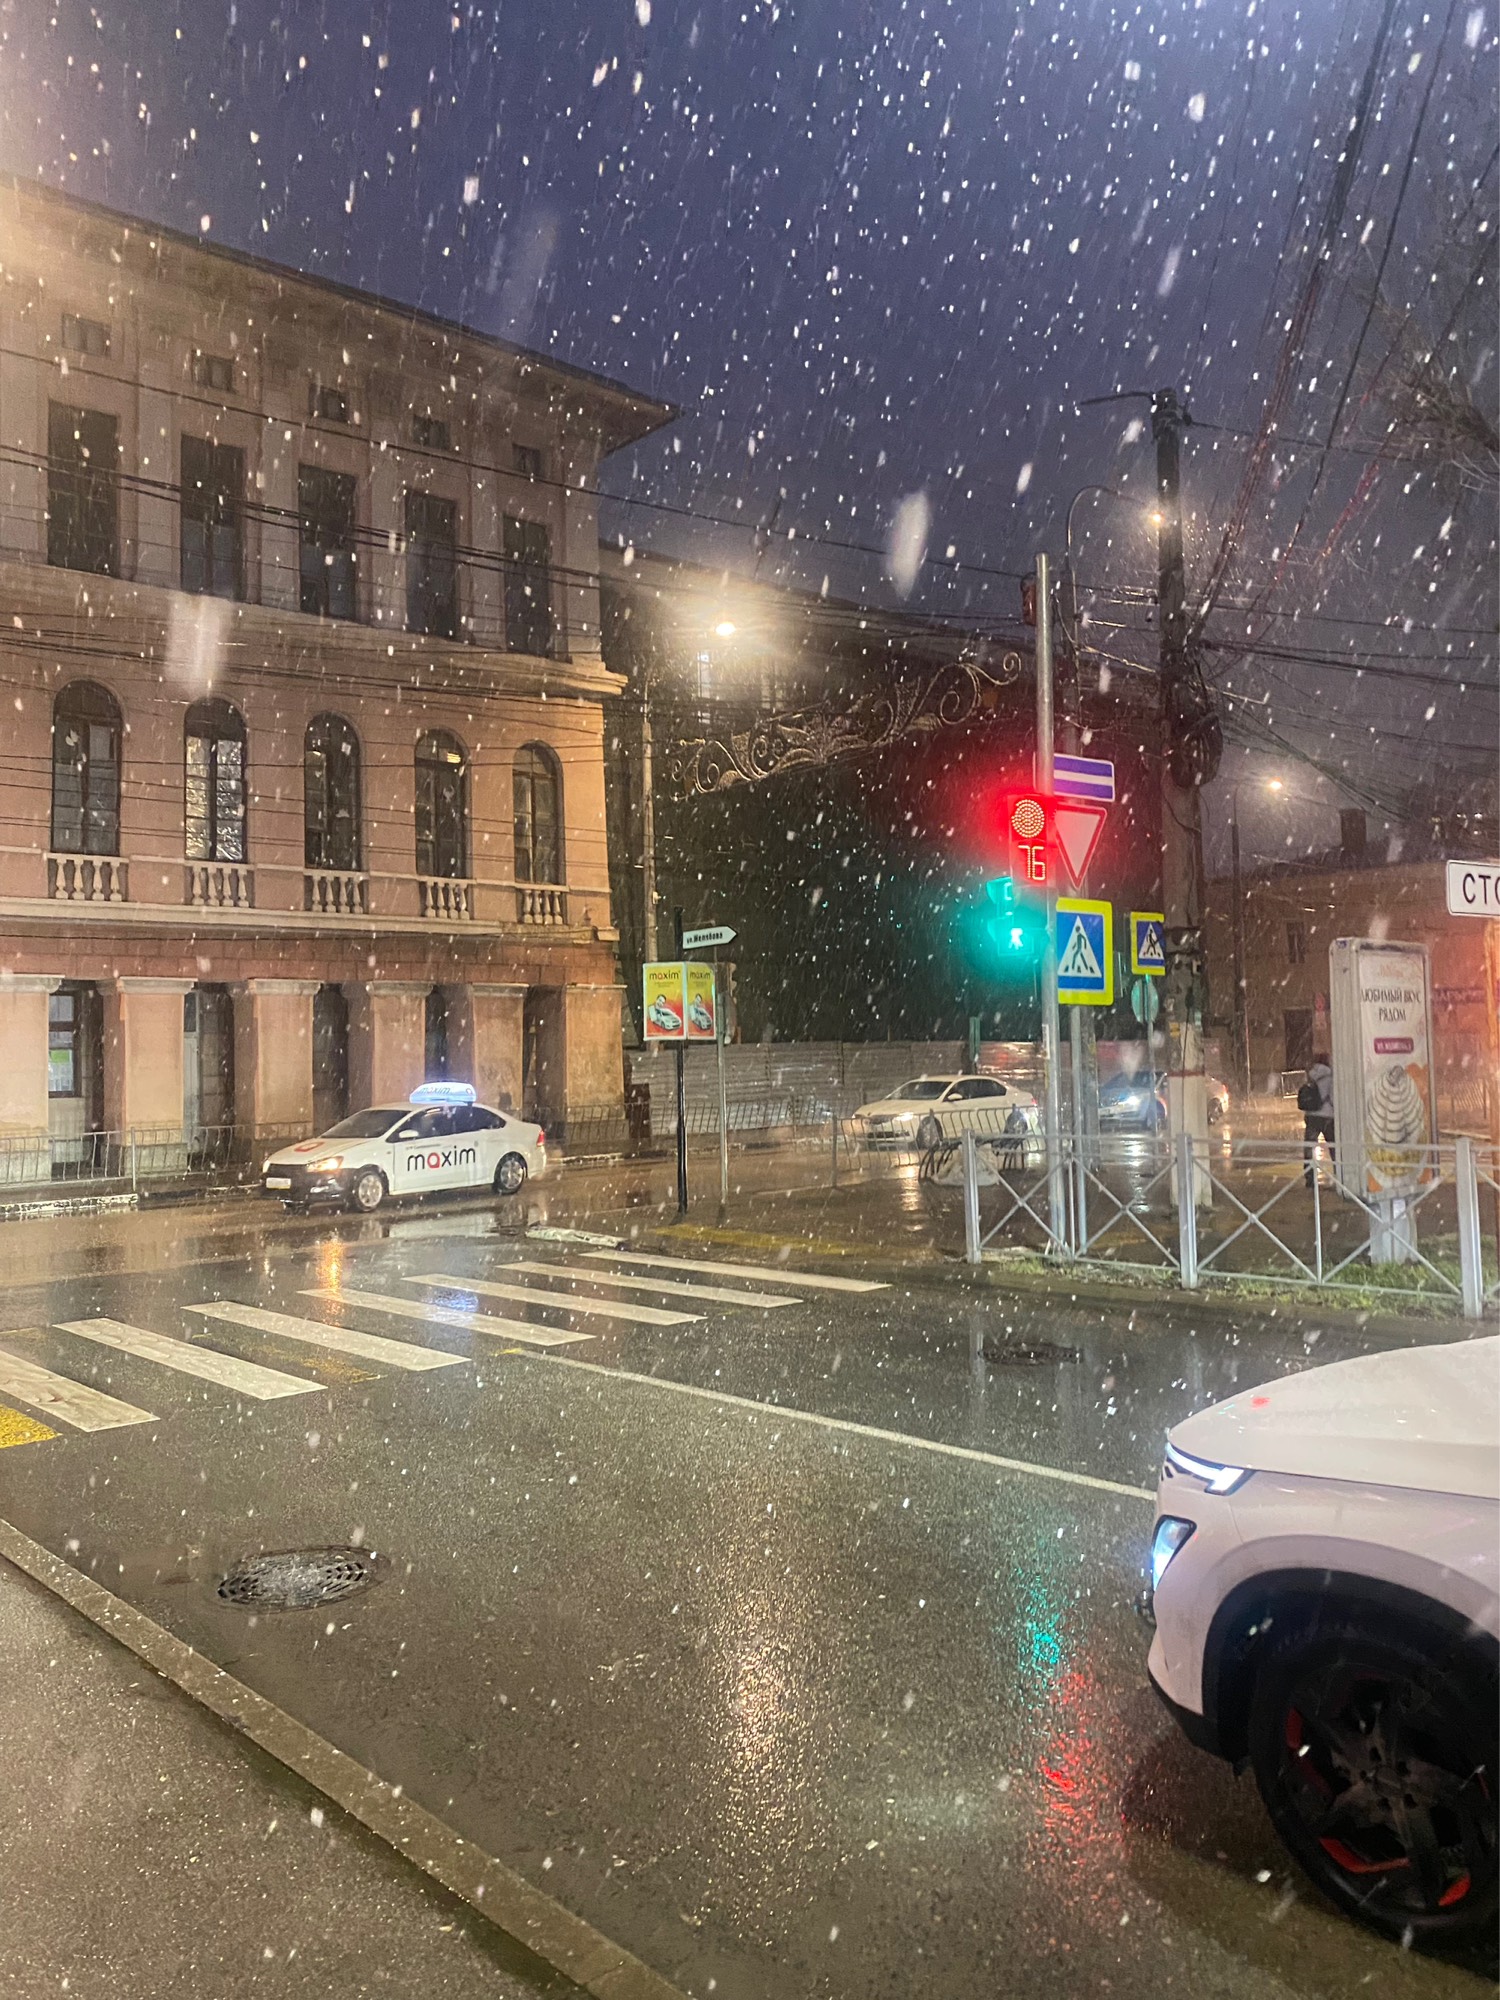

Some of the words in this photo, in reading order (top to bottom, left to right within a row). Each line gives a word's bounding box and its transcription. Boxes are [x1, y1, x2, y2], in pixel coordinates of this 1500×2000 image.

[1018, 845, 1046, 881] 76
[649, 970, 679, 980] maxim
[690, 970, 711, 980] maxim
[1379, 1007, 1406, 1021] РЯДОМ
[419, 1086, 451, 1095] maxim
[407, 1145, 476, 1172] maxim
